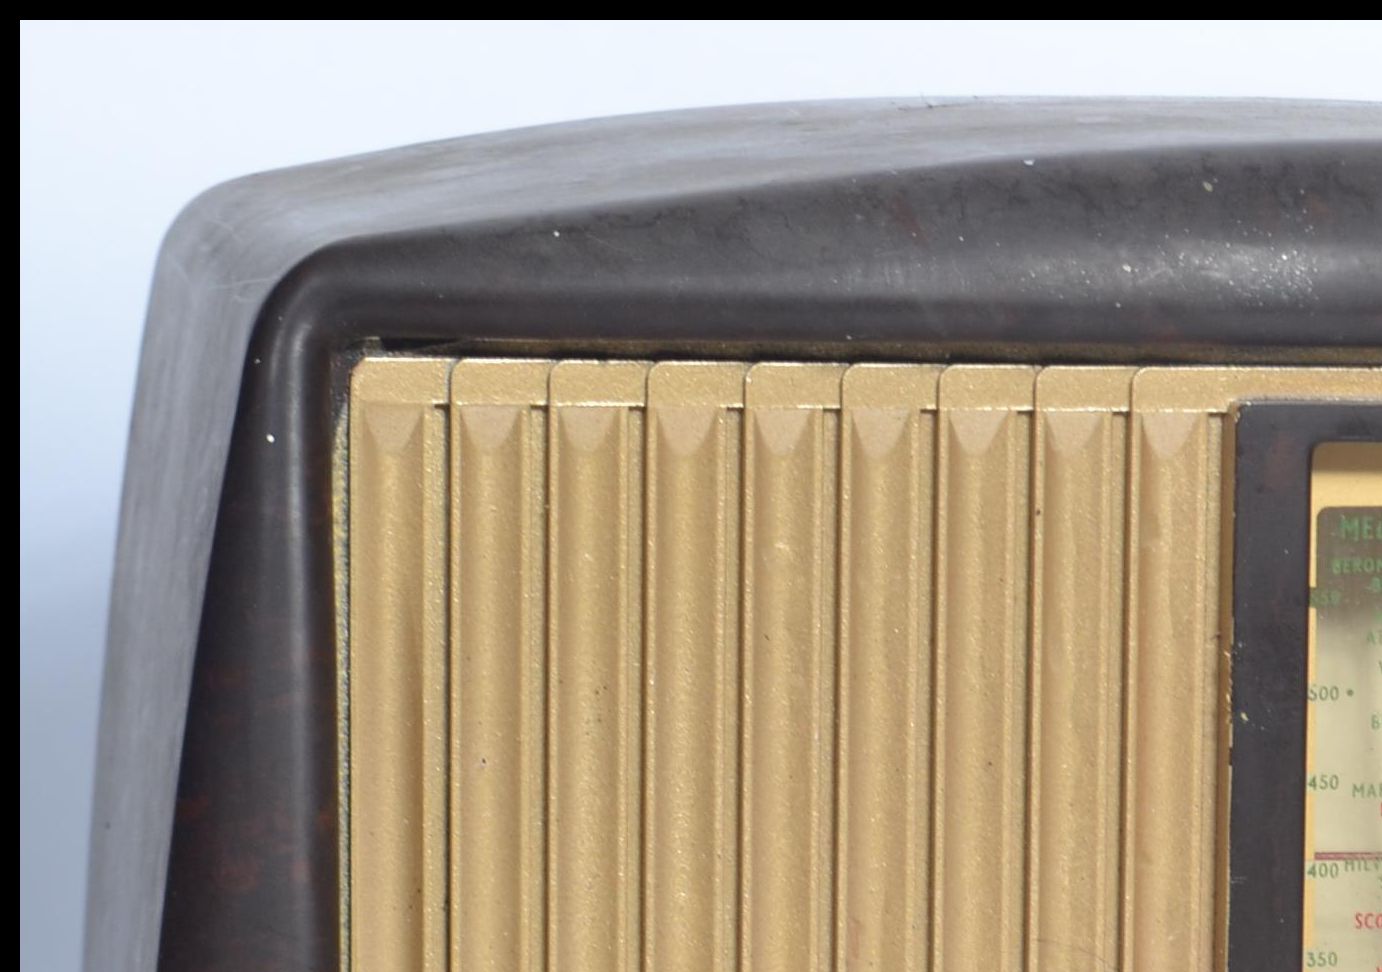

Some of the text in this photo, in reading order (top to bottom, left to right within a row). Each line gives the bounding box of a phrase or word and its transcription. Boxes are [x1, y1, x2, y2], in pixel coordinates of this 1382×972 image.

[1308, 685, 1340, 701] 500
[1308, 774, 1340, 791] 450
[1307, 862, 1339, 879] 400
[1306, 952, 1339, 968] 350
